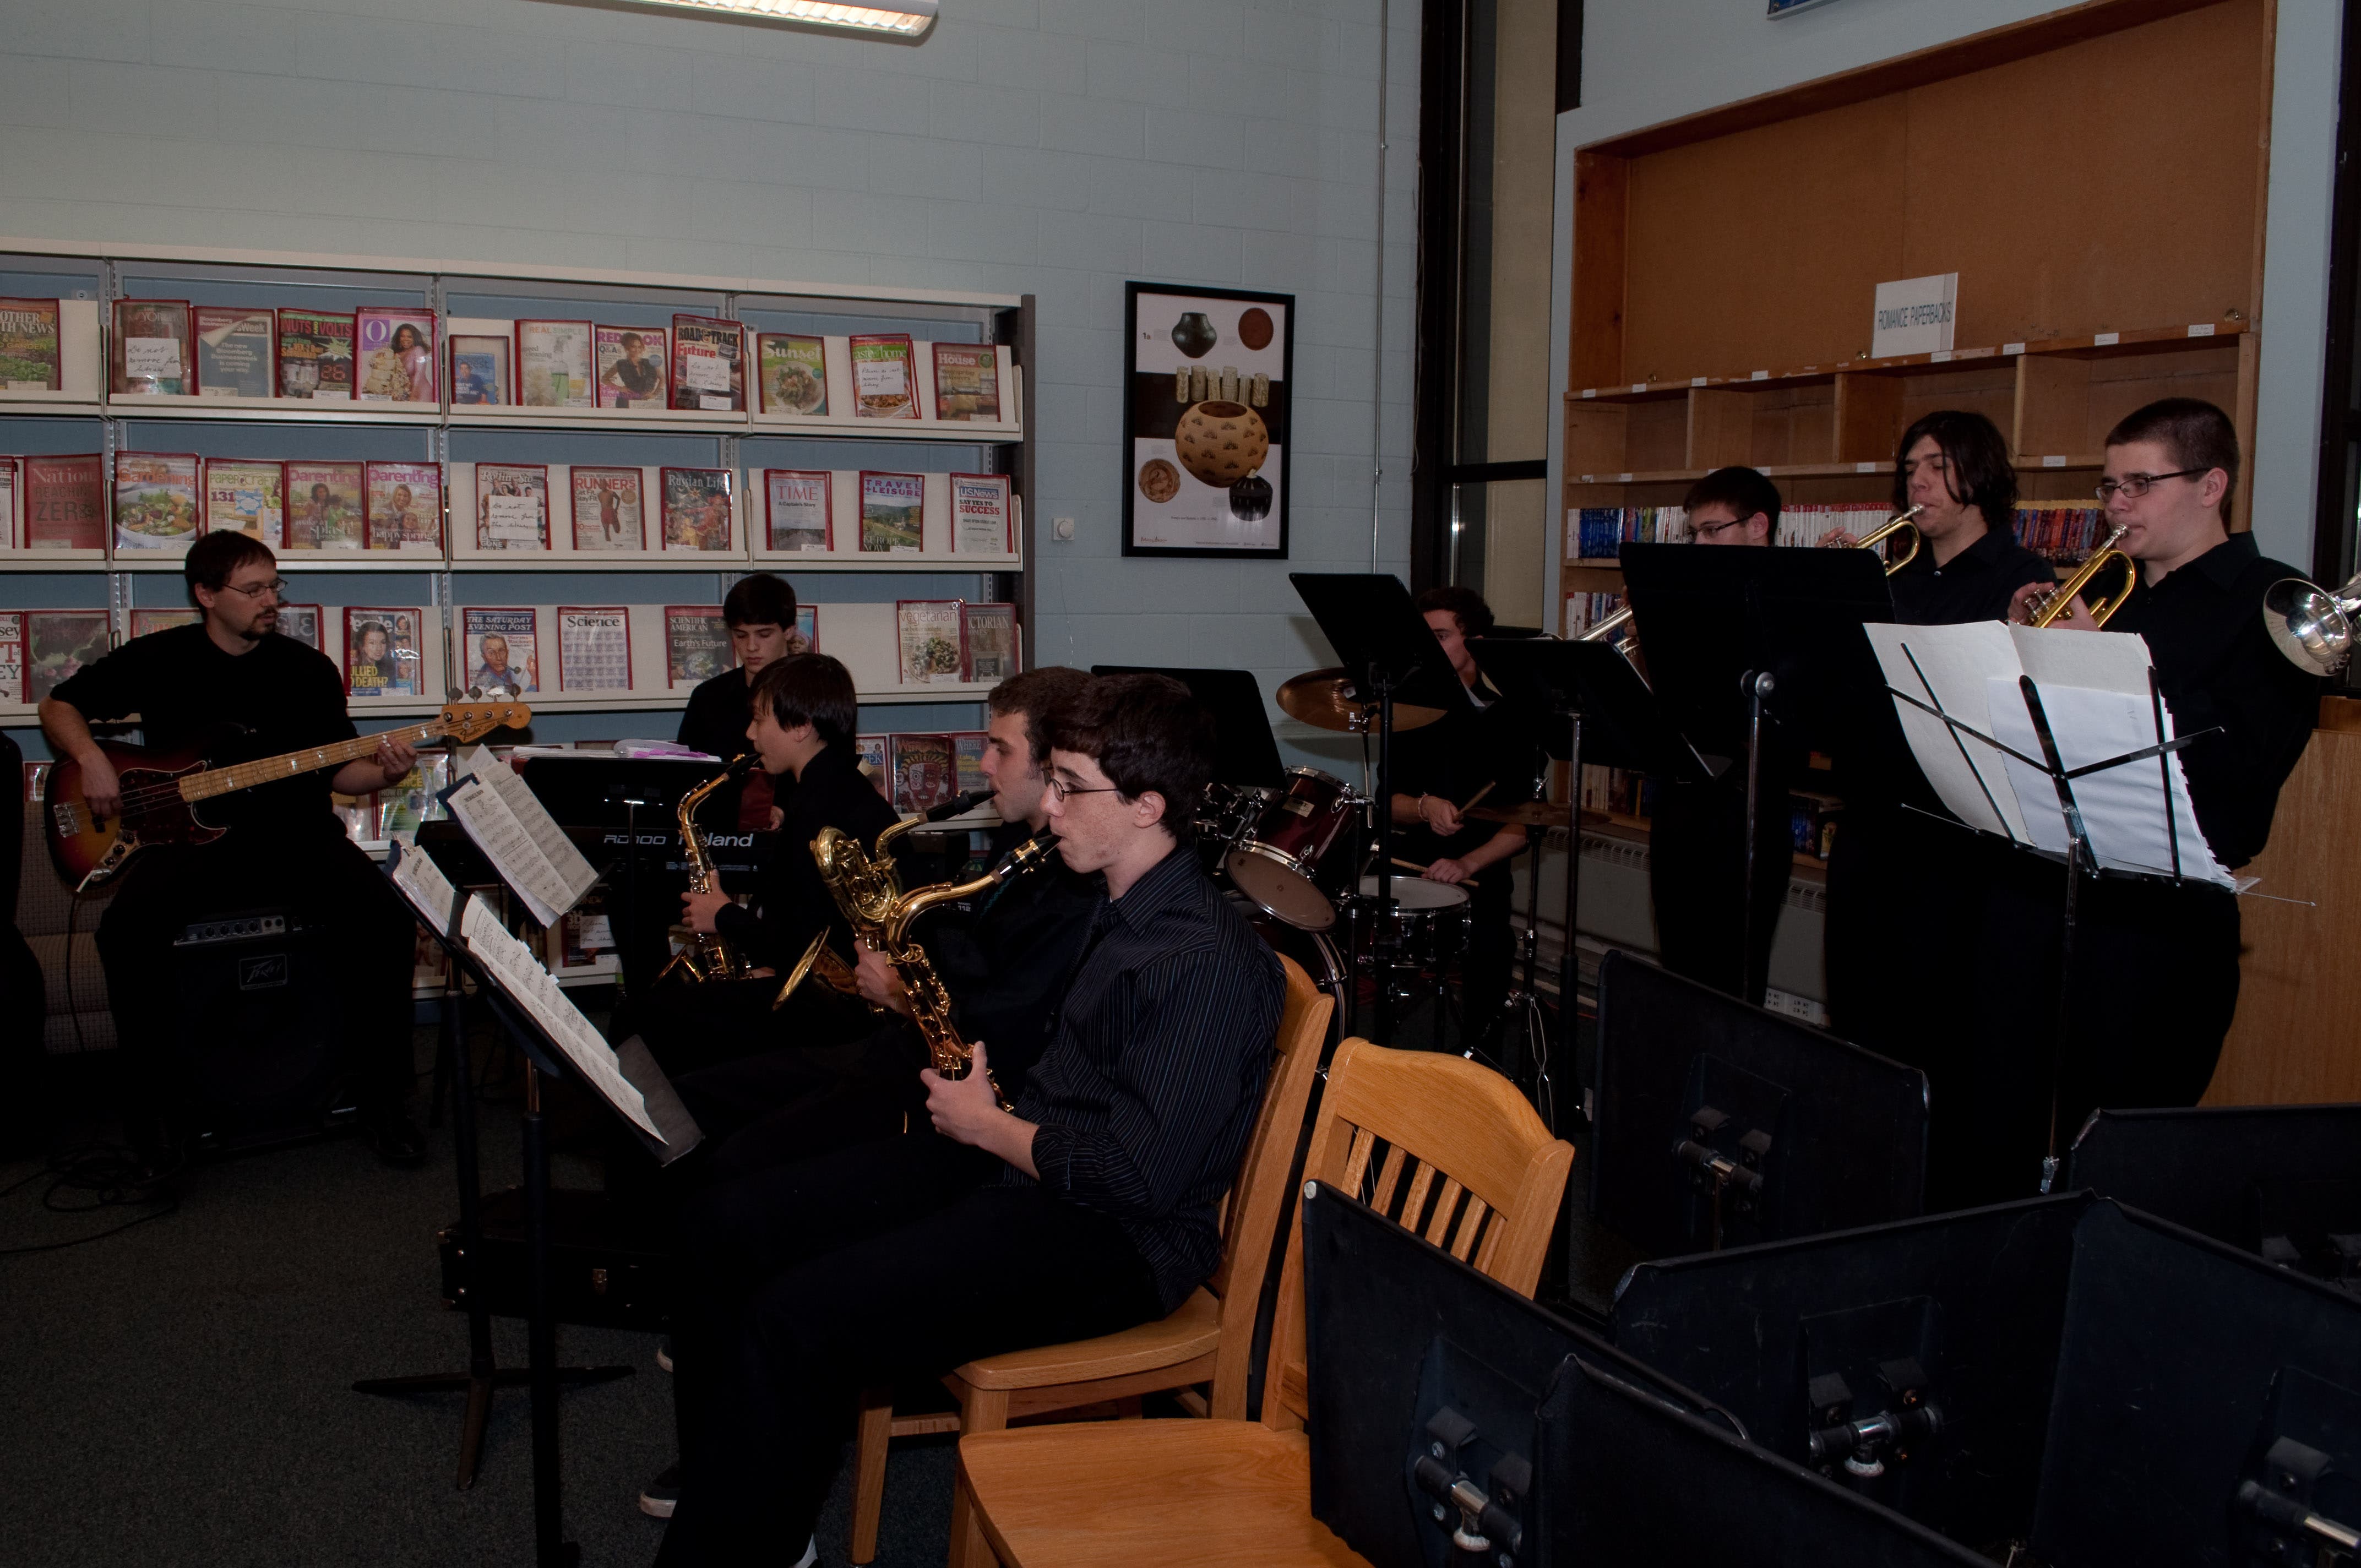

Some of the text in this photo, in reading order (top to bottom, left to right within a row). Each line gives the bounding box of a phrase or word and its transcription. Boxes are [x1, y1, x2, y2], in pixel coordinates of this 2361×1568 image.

[0, 311, 40, 323] OTHER
[1878, 302, 1951, 331] ROMANCE PAPERBACKS
[20, 323, 55, 334] NEWS
[281, 319, 311, 334] NUTS
[319, 322, 353, 337] VOLTS
[366, 320, 387, 342] O
[597, 331, 663, 346] REDOK
[677, 327, 703, 341] ROAD
[711, 330, 739, 347] TRACK
[677, 342, 716, 358] Future
[763, 341, 823, 361] Sunset
[880, 346, 907, 358] home
[938, 354, 976, 366] House
[118, 469, 197, 489] Gardening
[367, 467, 439, 489] Parenting
[668, 474, 704, 487] Russian
[865, 479, 921, 489] TRAVEL
[211, 491, 235, 503] 131
[776, 486, 818, 500] TIME
[865, 486, 921, 497] +LEISURE
[959, 505, 1000, 515] SUCCESS
[485, 616, 532, 624] SATURDAY
[567, 615, 621, 628] Science
[967, 616, 1009, 629] ICTORIAN
[670, 624, 709, 632] AMERICAN
[350, 665, 378, 677] ULLIED
[357, 677, 389, 688] DEATH?
